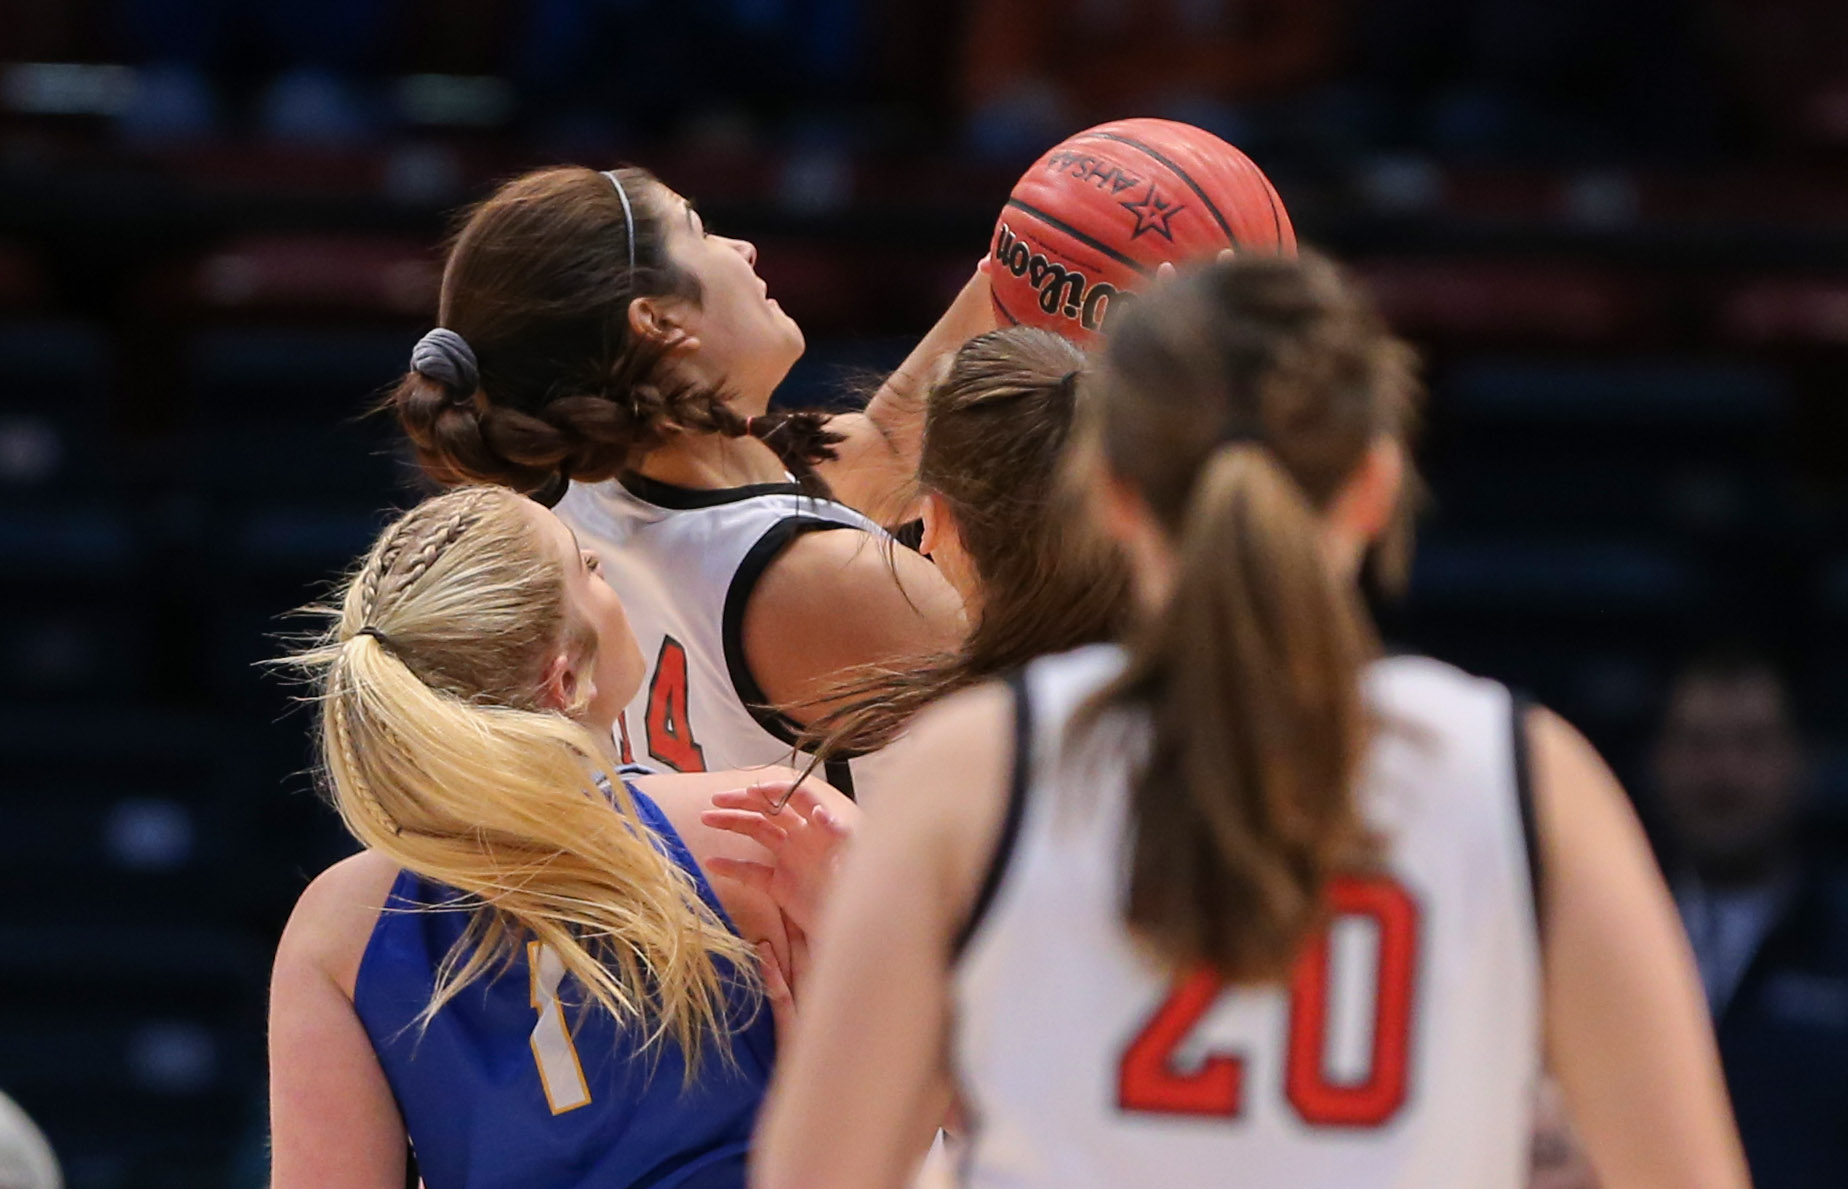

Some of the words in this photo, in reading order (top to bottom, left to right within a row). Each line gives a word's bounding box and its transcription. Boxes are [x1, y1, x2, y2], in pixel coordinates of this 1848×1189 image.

[612, 634, 707, 772] 4
[527, 941, 592, 1116] 1
[1117, 875, 1422, 1128] 20
